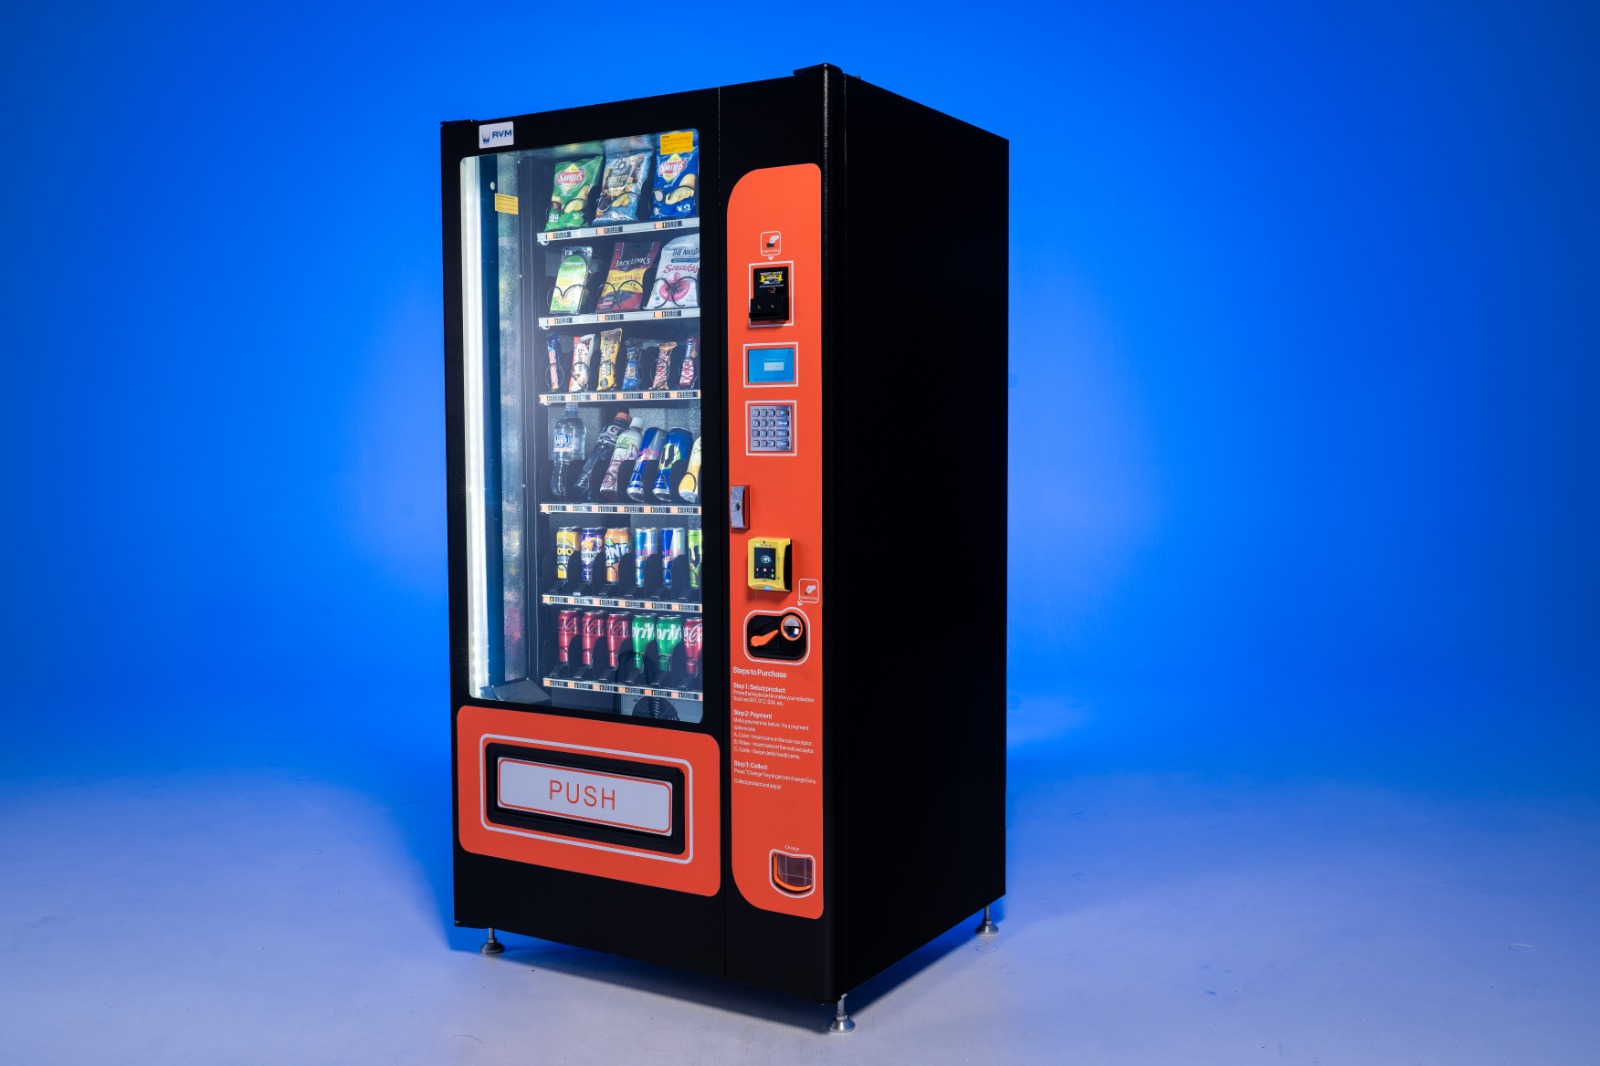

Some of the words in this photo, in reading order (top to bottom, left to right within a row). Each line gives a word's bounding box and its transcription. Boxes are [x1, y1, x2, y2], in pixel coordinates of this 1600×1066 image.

[492, 129, 512, 139] RVM
[757, 669, 787, 678] Purchase
[750, 711, 773, 719] Payment
[750, 762, 768, 770] Collect
[549, 778, 616, 812] PUSH
